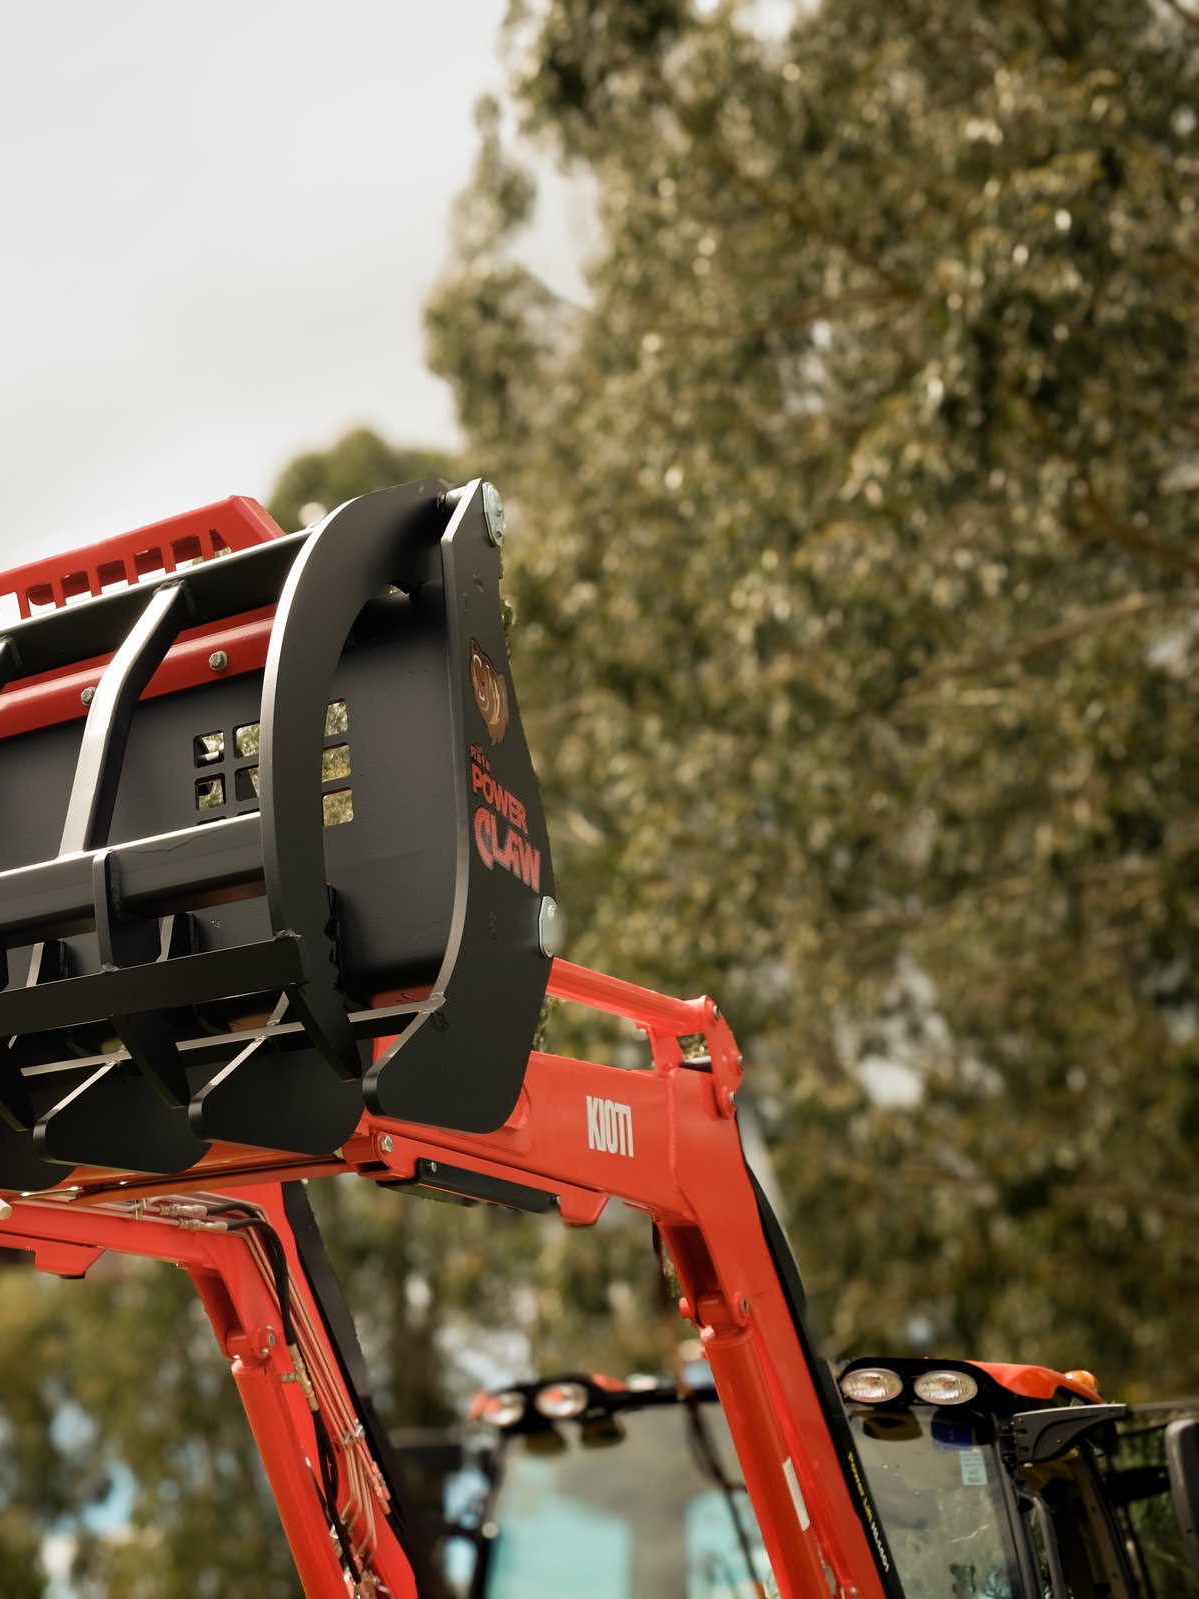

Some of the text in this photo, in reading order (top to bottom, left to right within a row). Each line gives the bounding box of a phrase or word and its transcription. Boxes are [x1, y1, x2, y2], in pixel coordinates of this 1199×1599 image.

[472, 763, 528, 834] POWER
[474, 806, 540, 893] CLAW
[586, 1095, 634, 1158] KIOTI
[849, 1453, 865, 1496] Power
